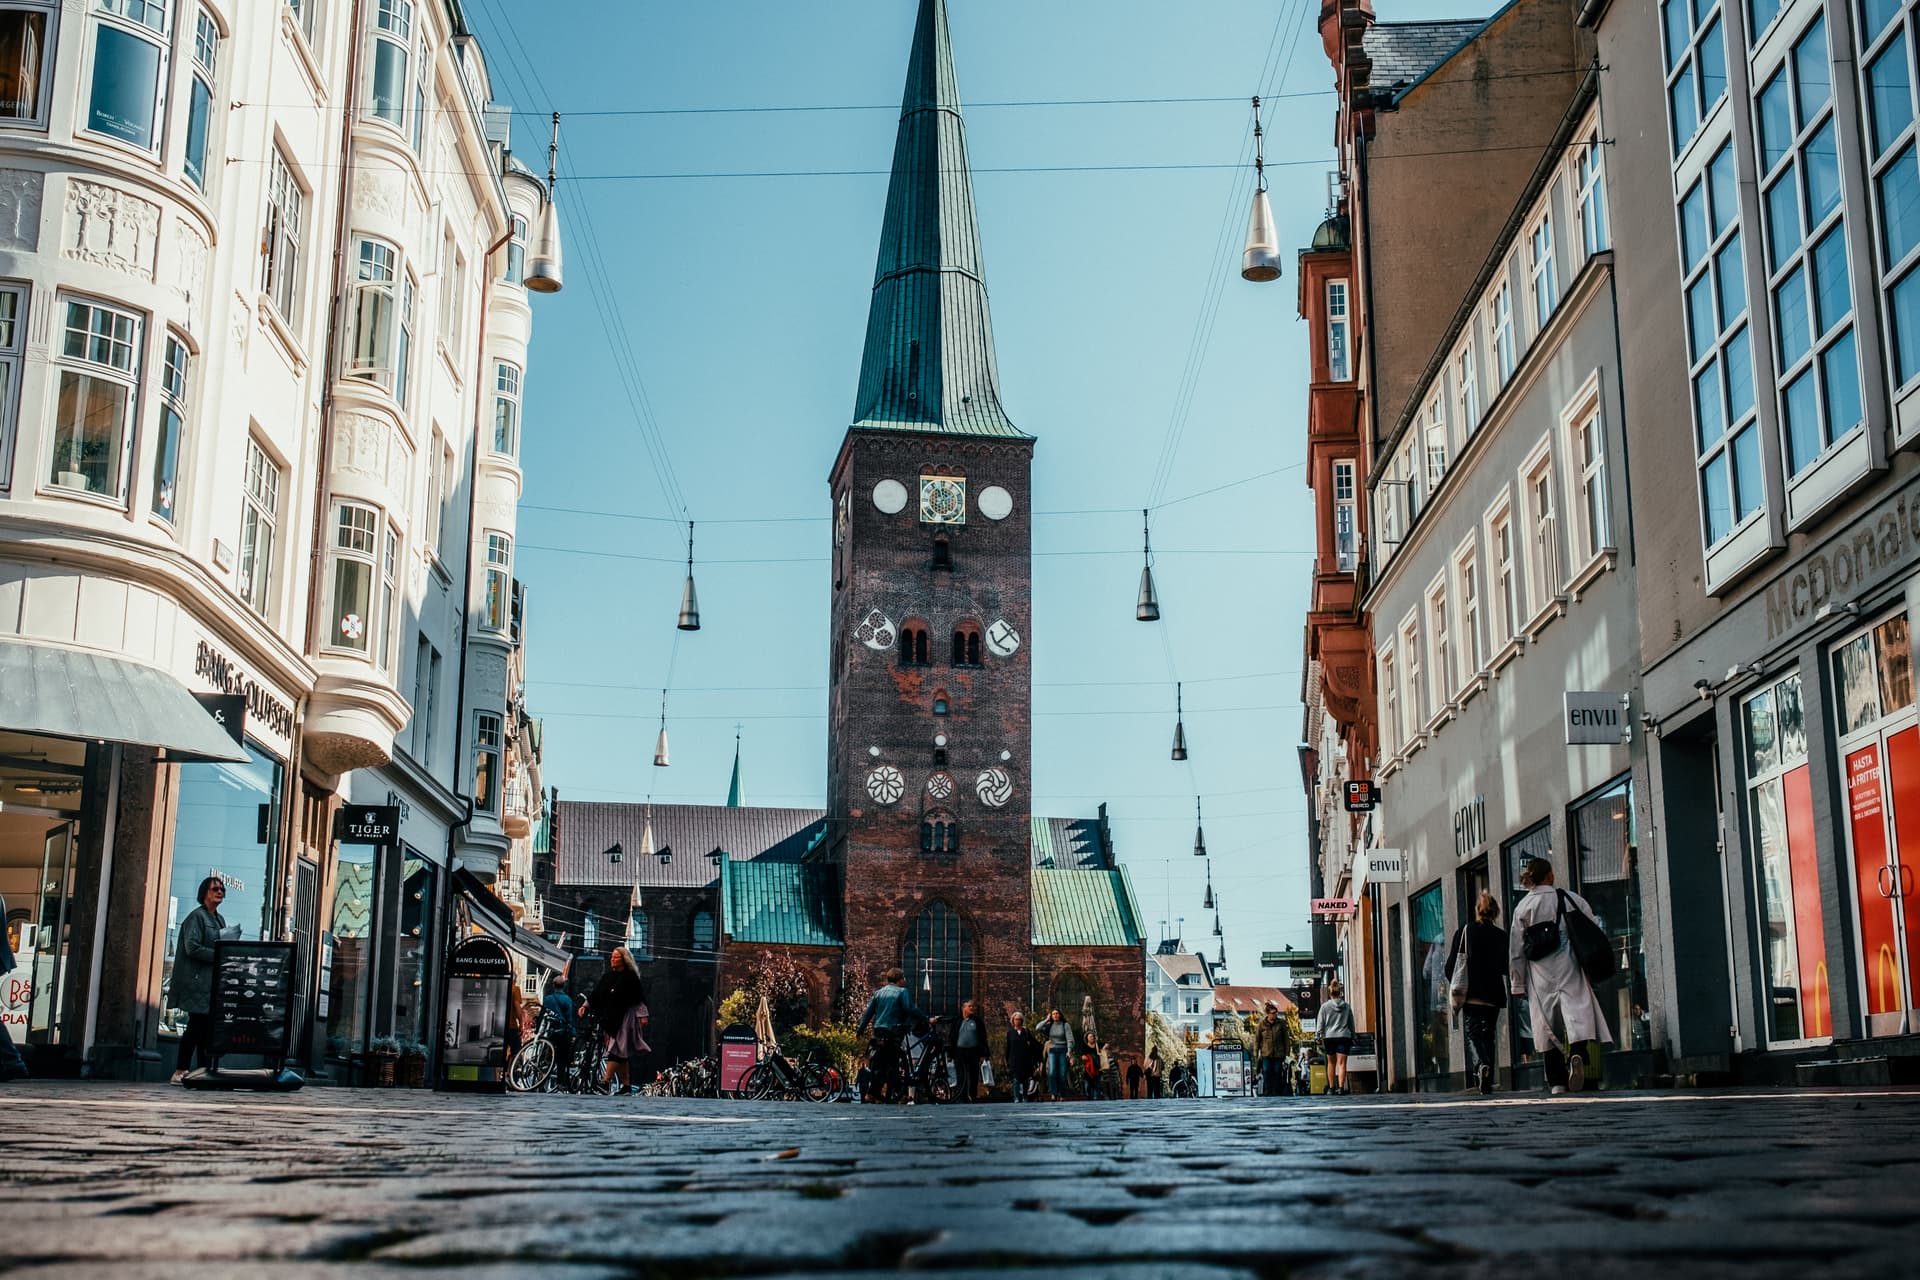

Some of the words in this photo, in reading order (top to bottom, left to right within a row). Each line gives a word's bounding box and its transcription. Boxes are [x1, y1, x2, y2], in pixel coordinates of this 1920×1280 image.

[1853, 754, 1873, 771] HASTA
[1848, 774, 1857, 789] LA
[349, 824, 391, 835] TIGER
[1318, 901, 1348, 909] NAKED
